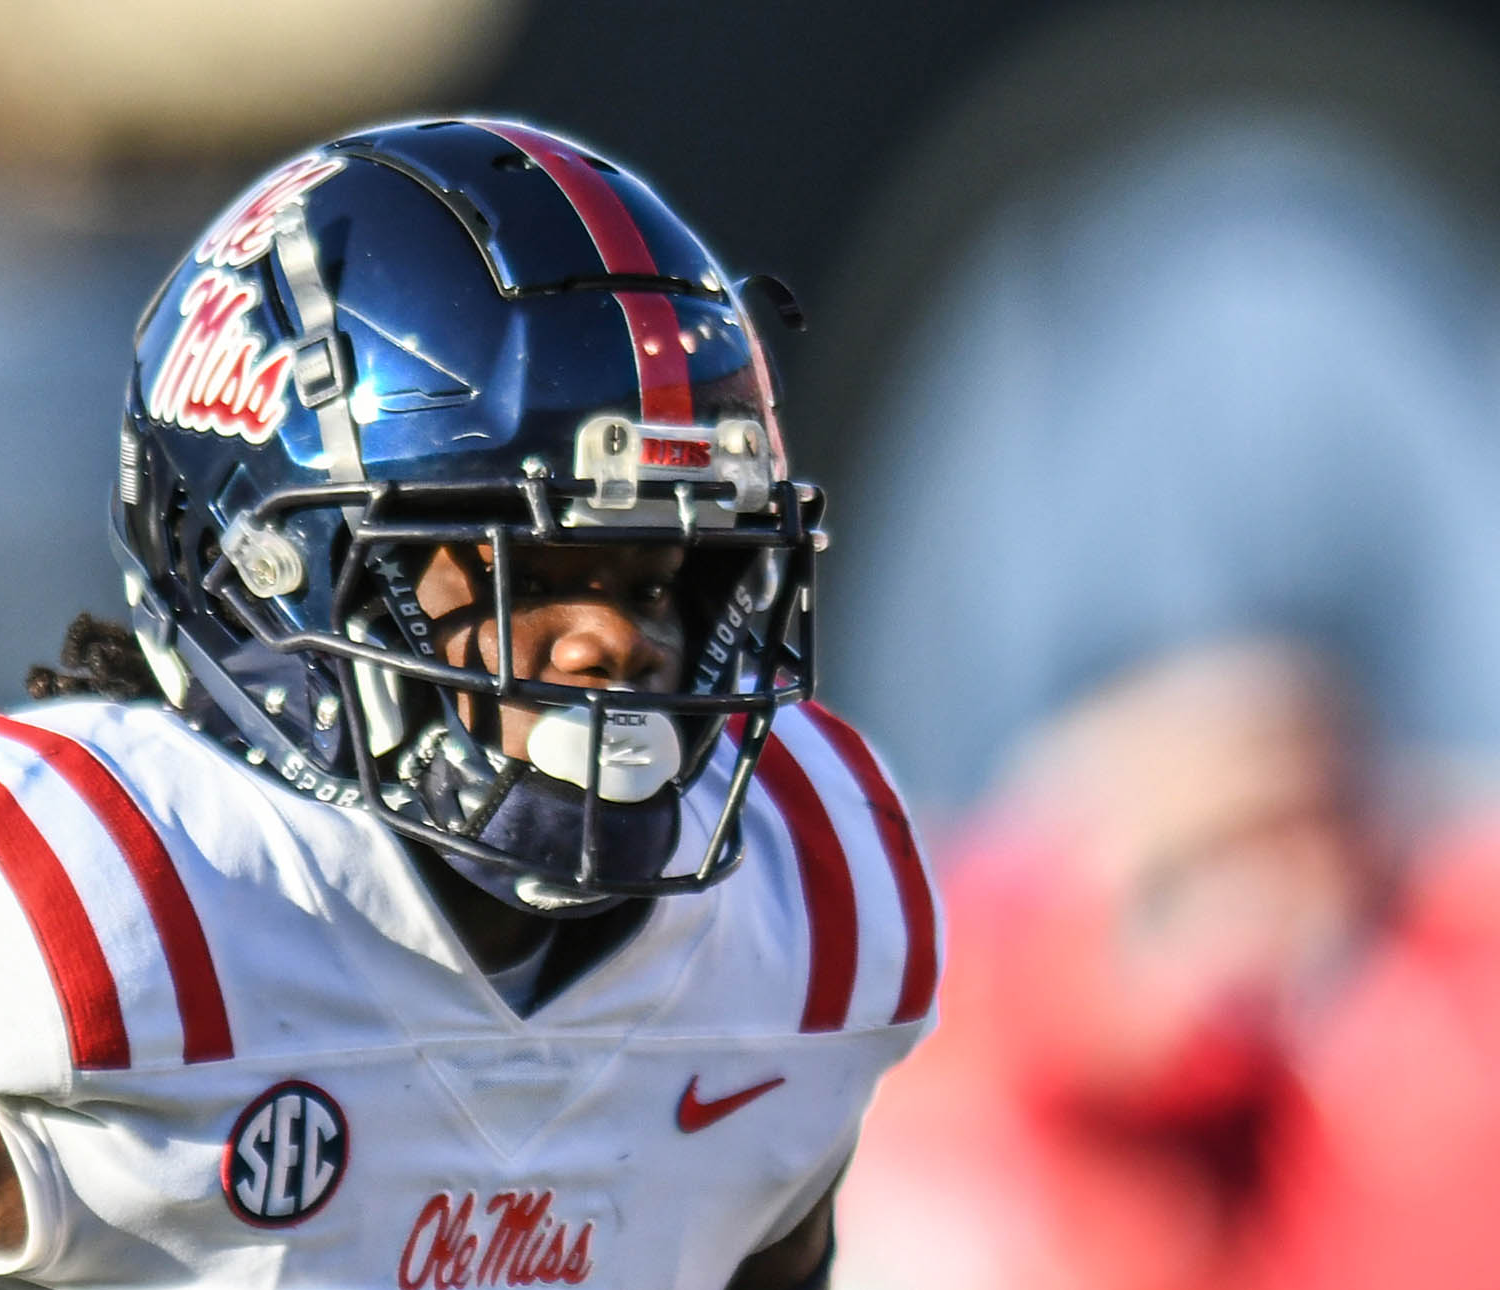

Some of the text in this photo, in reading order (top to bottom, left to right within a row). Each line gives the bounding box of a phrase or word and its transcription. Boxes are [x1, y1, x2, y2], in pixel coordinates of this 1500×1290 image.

[151, 270, 294, 442] Miss
[389, 586, 436, 656] PORT
[603, 713, 648, 727] HOCK
[282, 754, 371, 810] SPOR
[237, 1094, 339, 1217] SEC
[477, 1189, 595, 1288] Miss
